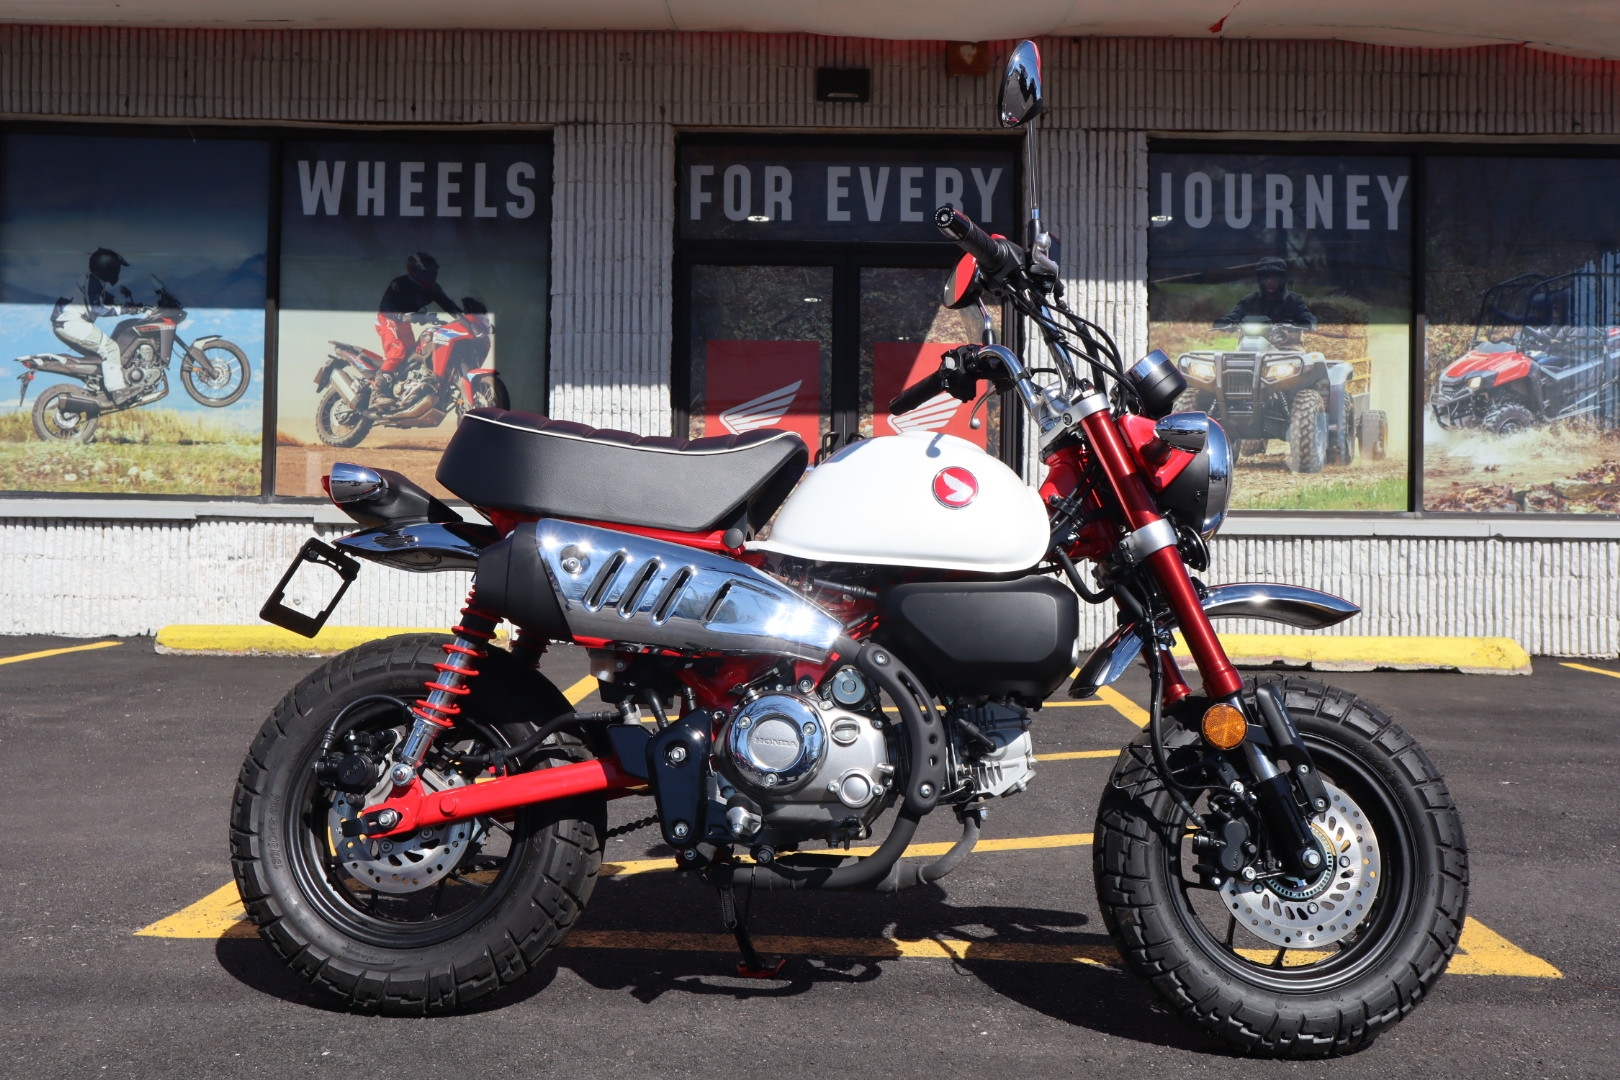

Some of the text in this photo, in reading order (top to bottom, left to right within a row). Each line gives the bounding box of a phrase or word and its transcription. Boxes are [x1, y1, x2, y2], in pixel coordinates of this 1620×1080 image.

[297, 160, 536, 219] WHEELS
[689, 164, 1004, 223] FOR EVERY
[1153, 172, 1409, 230] JOURNEY
[753, 737, 798, 747] HONDA
